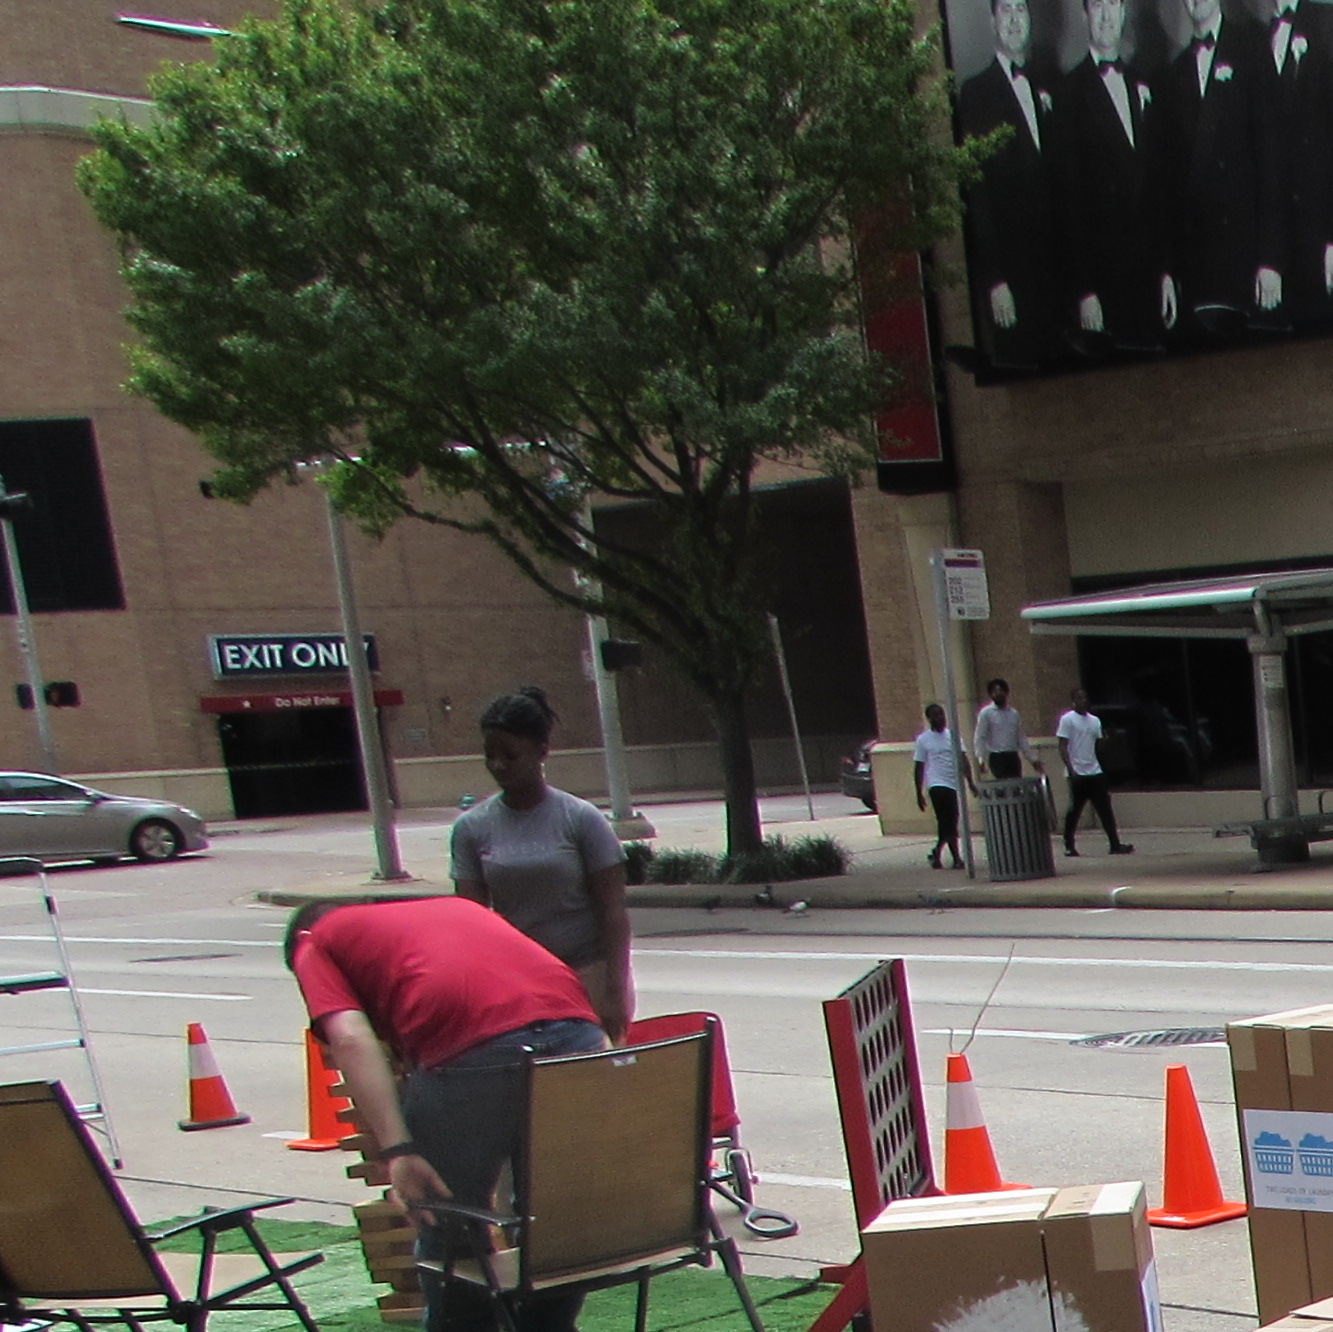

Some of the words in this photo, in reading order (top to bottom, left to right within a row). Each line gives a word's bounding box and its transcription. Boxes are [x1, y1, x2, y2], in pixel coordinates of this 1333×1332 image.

[223, 643, 285, 670] EXIT
[291, 642, 369, 668] ONL
[274, 697, 291, 708] Do
[293, 696, 312, 707] Not
[314, 695, 341, 706] Enter
